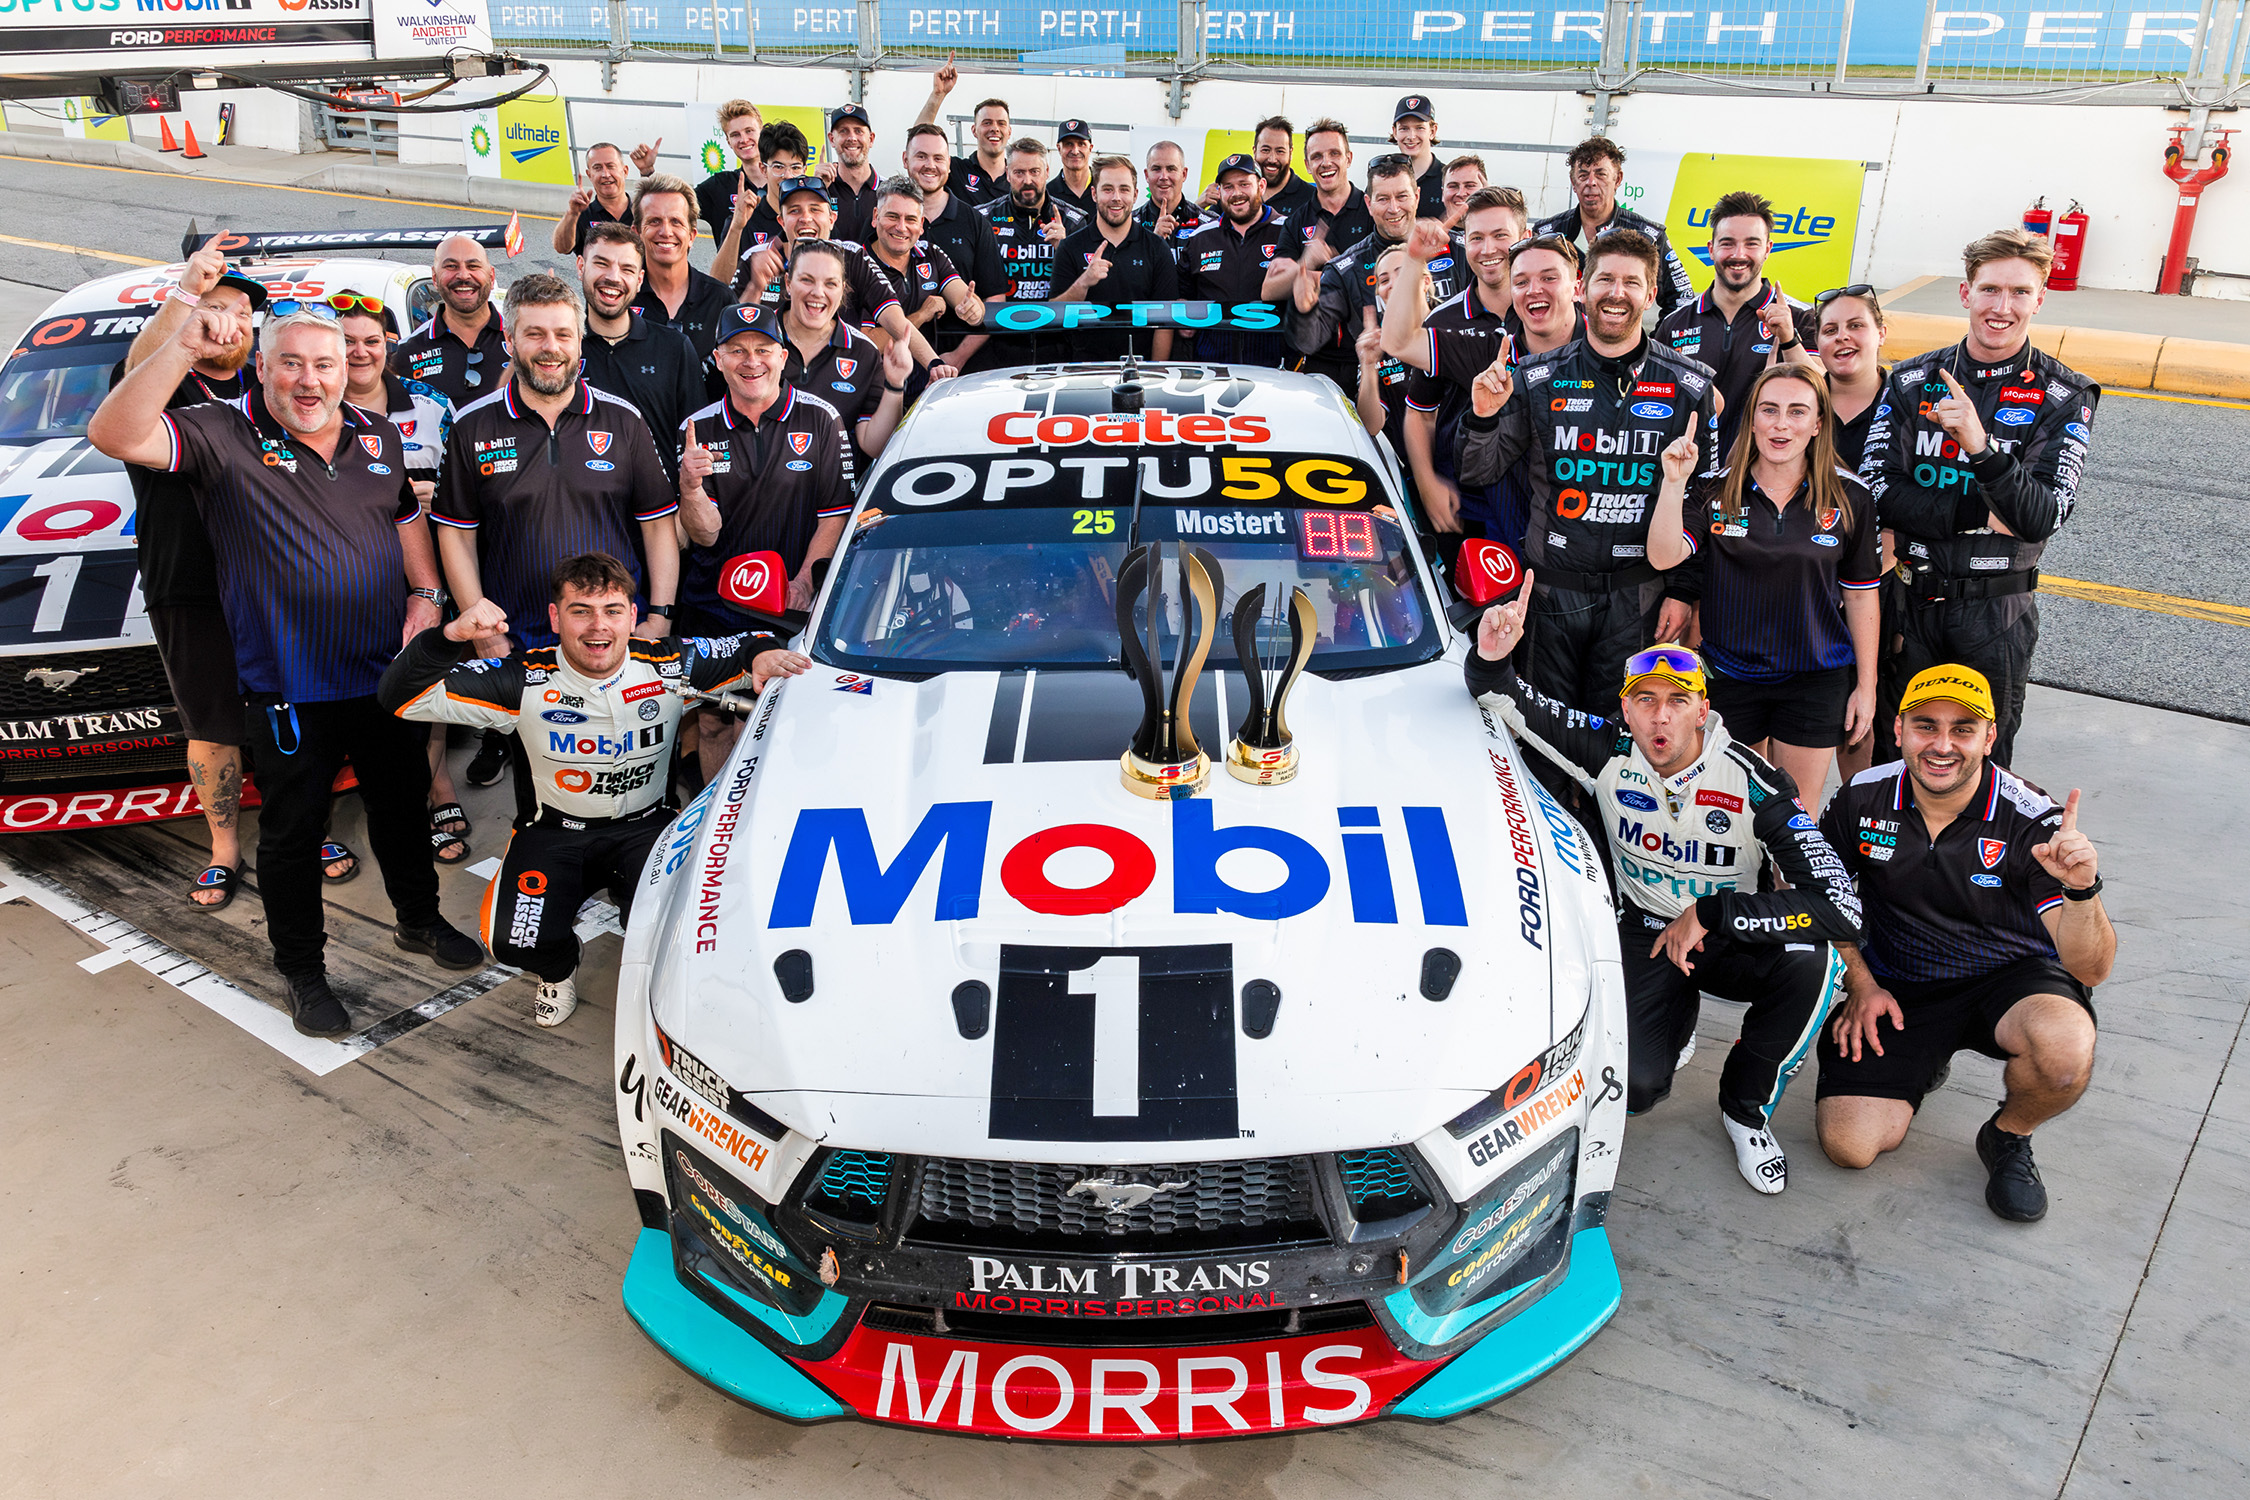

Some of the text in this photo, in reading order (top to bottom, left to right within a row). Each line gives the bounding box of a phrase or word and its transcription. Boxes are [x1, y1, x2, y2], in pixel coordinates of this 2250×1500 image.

[397, 14, 476, 26] WALKINSHAW
[502, 6, 564, 28] PERTH
[590, 7, 658, 29] PETH
[793, 9, 858, 33] PERT
[908, 9, 999, 36] PERTH
[1040, 10, 1142, 38] PERTH
[412, 26, 468, 37] ANDRETTI
[1930, 11, 2215, 49] PER
[424, 37, 457, 46] UNITED
[506, 122, 560, 144] ultimate
[1624, 182, 1645, 201] bp
[257, 231, 374, 247] TRUCK
[377, 228, 498, 243] ASSIST
[998, 244, 1037, 260] Mobil
[1004, 262, 1053, 277] PTUS
[1430, 260, 1450, 271] Ford
[117, 281, 325, 304] Coes
[995, 303, 1281, 331] OPTUS
[1673, 336, 1701, 347] OPTUS
[409, 349, 432, 363] Mobil
[412, 357, 443, 371] OPTUS
[1527, 368, 1704, 390] OMP OMP
[1553, 380, 1595, 389] OPTU5G
[1901, 370, 1925, 384] OMP
[1977, 367, 2003, 378] Mobil
[1636, 385, 1672, 394] MORRIS
[2003, 390, 2041, 400] MORRIS
[2047, 383, 2070, 399] OMP
[1563, 404, 1593, 412] ASSIST
[1566, 398, 1594, 406] TRUCK
[1639, 404, 1664, 417] Ford
[986, 409, 1272, 445] Coates
[2003, 410, 2026, 423] Ford
[475, 438, 503, 452] Mobil
[1554, 425, 1630, 455] Mobil
[478, 449, 517, 462] OPTUS
[494, 459, 518, 468] TRUCK
[891, 456, 1367, 507] OPTU5G
[1555, 457, 1656, 486] OPTUS
[1914, 463, 1974, 495] OPT
[1590, 492, 1649, 508] TRUCK
[1072, 510, 1116, 535] 25
[1176, 508, 1287, 535] Mostert
[1581, 507, 1646, 523] ASSIST
[1304, 511, 1375, 558] 88
[1548, 533, 1567, 547] OMP
[1485, 553, 1510, 576] M
[734, 567, 763, 590] M
[33, 555, 84, 633] 1
[525, 671, 547, 682] OMP
[659, 662, 683, 676] OMP
[598, 675, 620, 693] Mobil
[625, 684, 662, 699] MORRIS
[1912, 676, 1984, 696] DUNLOP
[58, 709, 162, 741] TRANS
[551, 711, 578, 723] Ford
[752, 694, 780, 741] DUNLOP
[0, 735, 176, 760] ORRIS PERSONAL
[549, 730, 634, 759] Mobil
[596, 759, 660, 784] TRUCK
[1675, 769, 1698, 787] Mobil
[588, 771, 655, 798] ASSIST
[1176, 779, 1204, 793] WINNER
[3, 784, 205, 828] ORRI
[1622, 792, 1649, 809] Ford
[1699, 793, 1740, 809] MORRIS
[434, 807, 462, 823] EVERLAST
[562, 819, 586, 831] OMP
[1528, 777, 1582, 876] move
[1618, 815, 1699, 863] Mobil
[1871, 845, 1895, 855] RUCK
[766, 798, 1470, 930] Mobil
[508, 892, 529, 948] ASSIST
[523, 897, 545, 949] TRUCK
[1643, 916, 1666, 931] OMP
[1733, 912, 1813, 933] OPTU5G
[1068, 955, 1140, 1118] 1
[1544, 1022, 1585, 1070] TRUC
[671, 1044, 730, 1099] TRUCK
[671, 1062, 730, 1113] ASSIST
[655, 1076, 769, 1172] GEARWRENCH
[1467, 1069, 1586, 1167] GEARWRENCH
[1240, 1129, 1256, 1138] TM
[676, 1149, 787, 1259] CORESTAFF
[1452, 1147, 1566, 1255] CORESTAFF
[690, 1193, 792, 1289] GOODYEAR
[1447, 1194, 1551, 1288] GOODYEAR
[710, 1227, 774, 1290] AUTOCARE
[1466, 1226, 1532, 1289] AUTOCARE
[967, 1256, 1272, 1300] PALM TRANS
[955, 1290, 1286, 1318] MORRIS PERSONAL
[875, 1342, 1372, 1435] MORRIS
